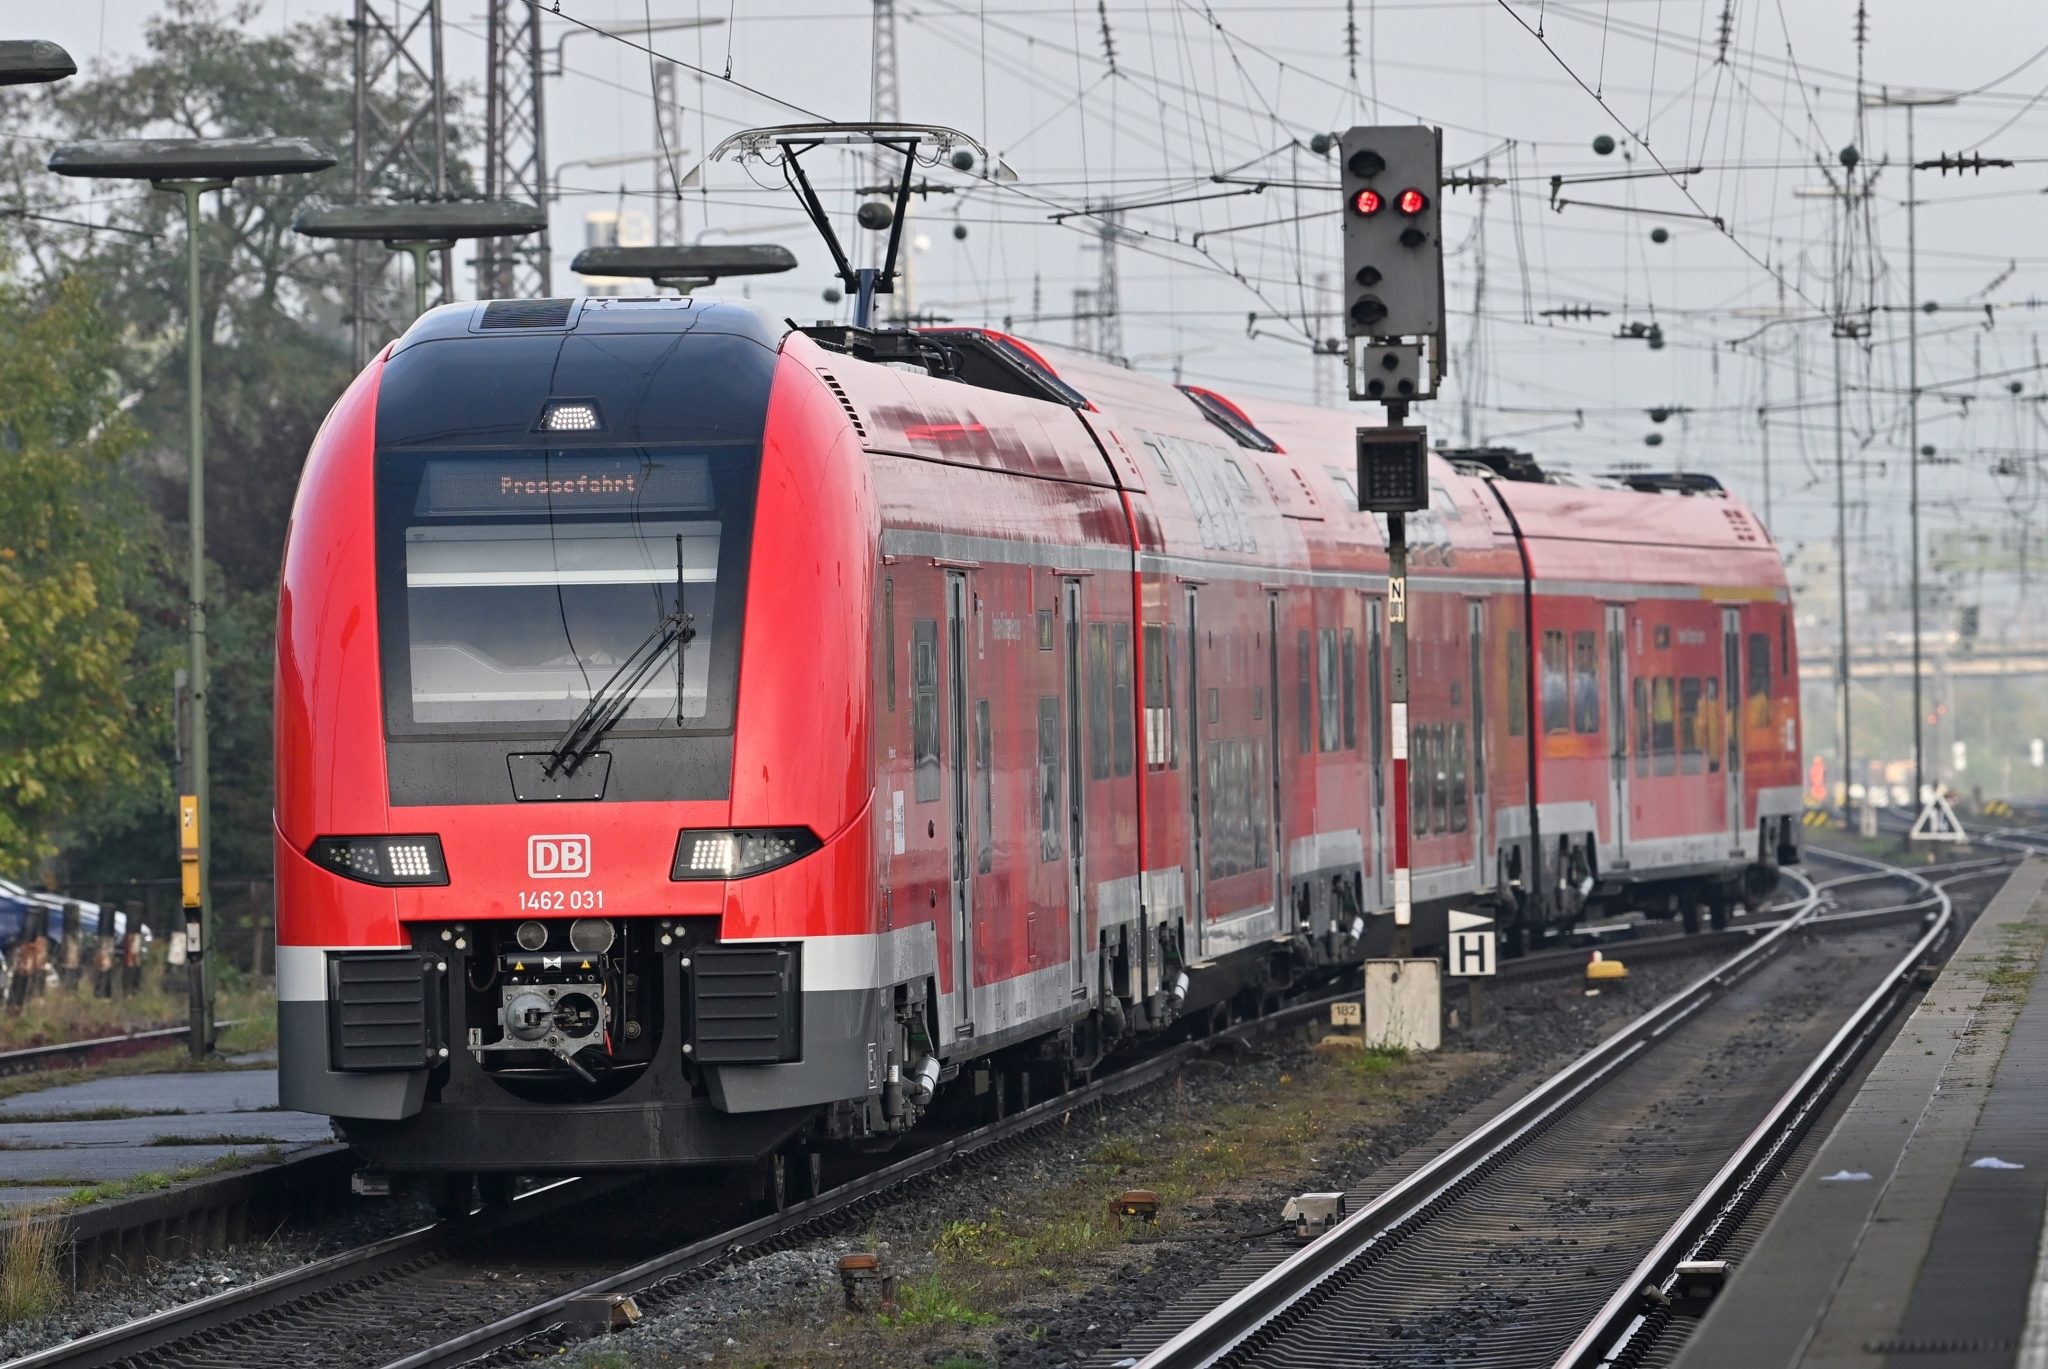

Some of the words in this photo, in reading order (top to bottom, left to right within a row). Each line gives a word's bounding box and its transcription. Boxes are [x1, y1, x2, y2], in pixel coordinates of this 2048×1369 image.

[501, 475, 635, 493] Pressefahrt
[1392, 582, 1401, 598] N
[536, 841, 584, 871] DB
[518, 891, 565, 911] 1462
[570, 890, 603, 910] 031
[1459, 935, 1485, 973] H
[1336, 1004, 1357, 1016] 182
